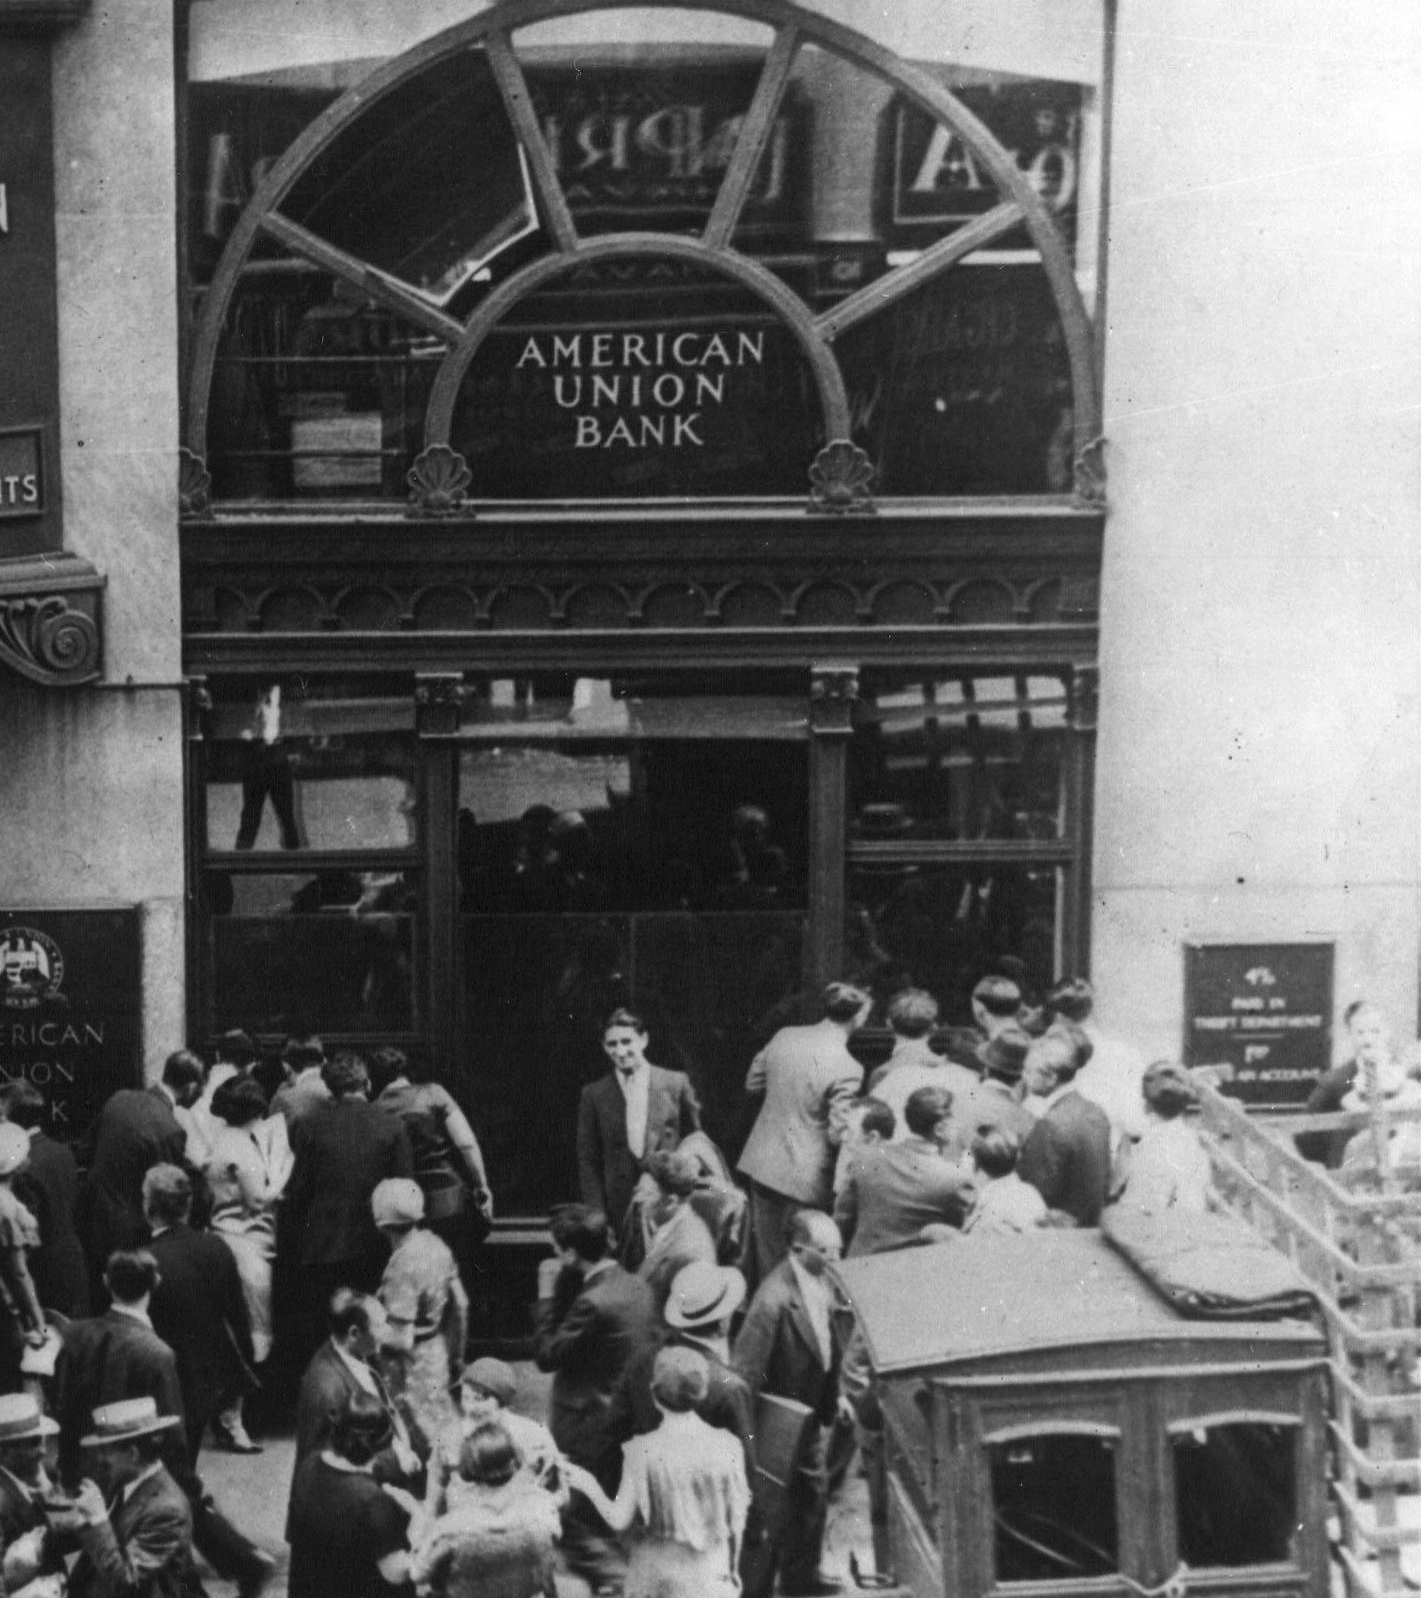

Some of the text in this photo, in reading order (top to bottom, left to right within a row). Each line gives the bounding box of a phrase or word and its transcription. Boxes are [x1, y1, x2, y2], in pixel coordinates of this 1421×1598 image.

[515, 331, 764, 368] AMERICAN
[553, 373, 727, 408] UNION
[575, 412, 705, 448] BANK
